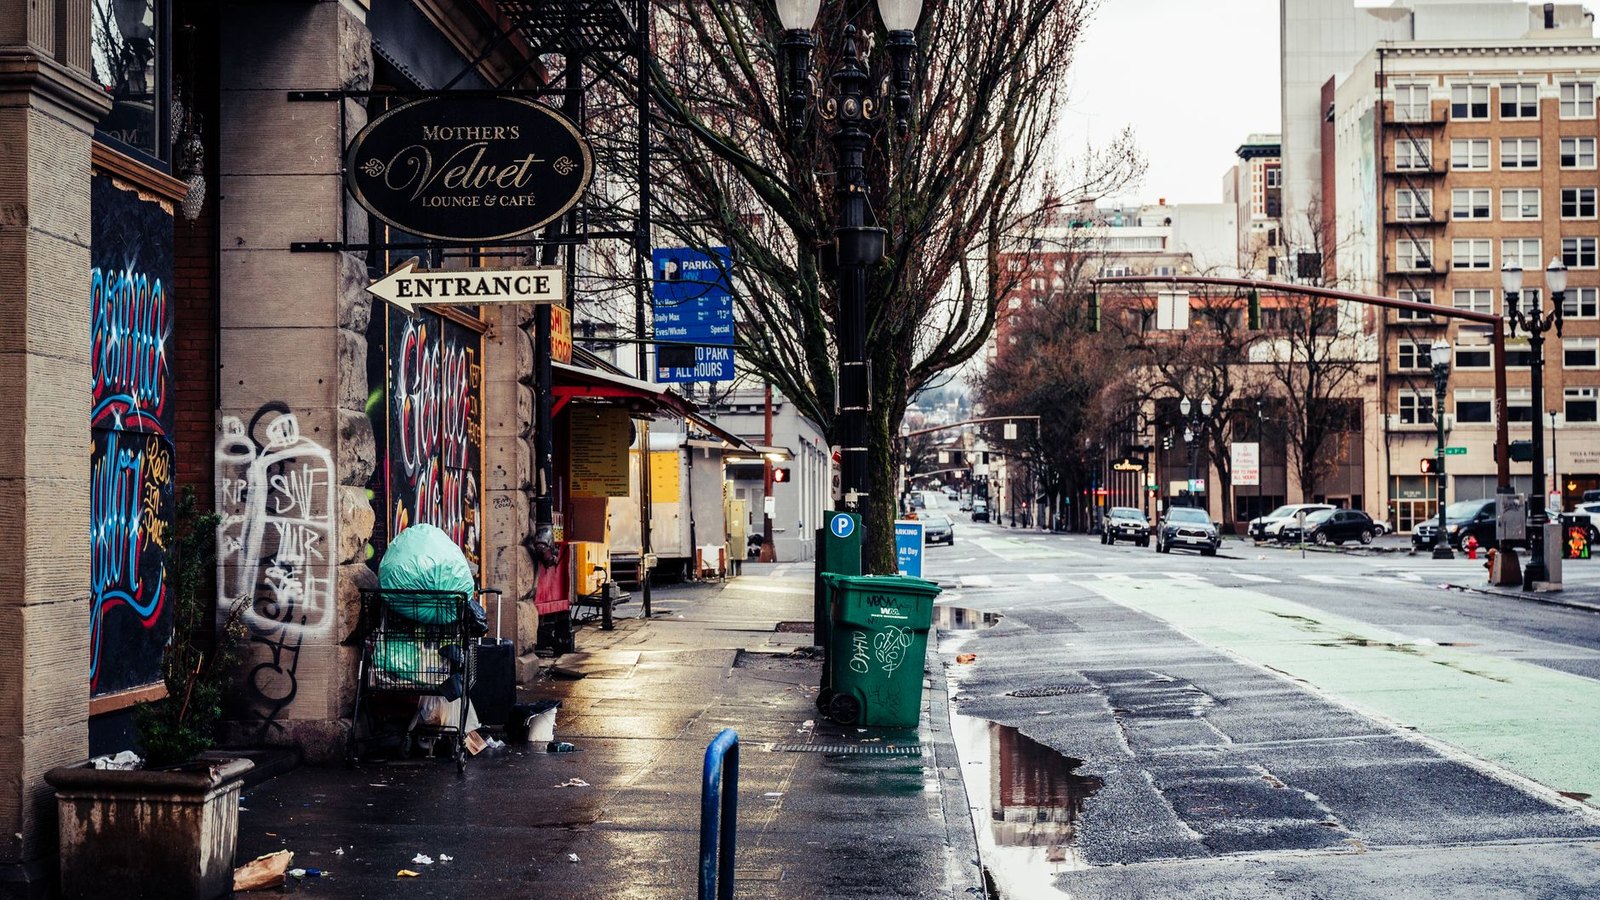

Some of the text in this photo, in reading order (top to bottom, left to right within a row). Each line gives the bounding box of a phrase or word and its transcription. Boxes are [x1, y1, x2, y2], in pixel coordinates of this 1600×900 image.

[423, 125, 520, 140] MOTHER'S
[384, 142, 545, 201] Velvet
[422, 193, 536, 207] LOUNGE & CAFÉ
[396, 276, 550, 297] ENTRANCE
[654, 313, 680, 323] Daily Max
[710, 324, 730, 336] Special
[706, 347, 729, 361] PARK
[675, 361, 723, 378] ALL HOURS
[895, 528, 918, 536] ARKING
[907, 547, 919, 557] Day
